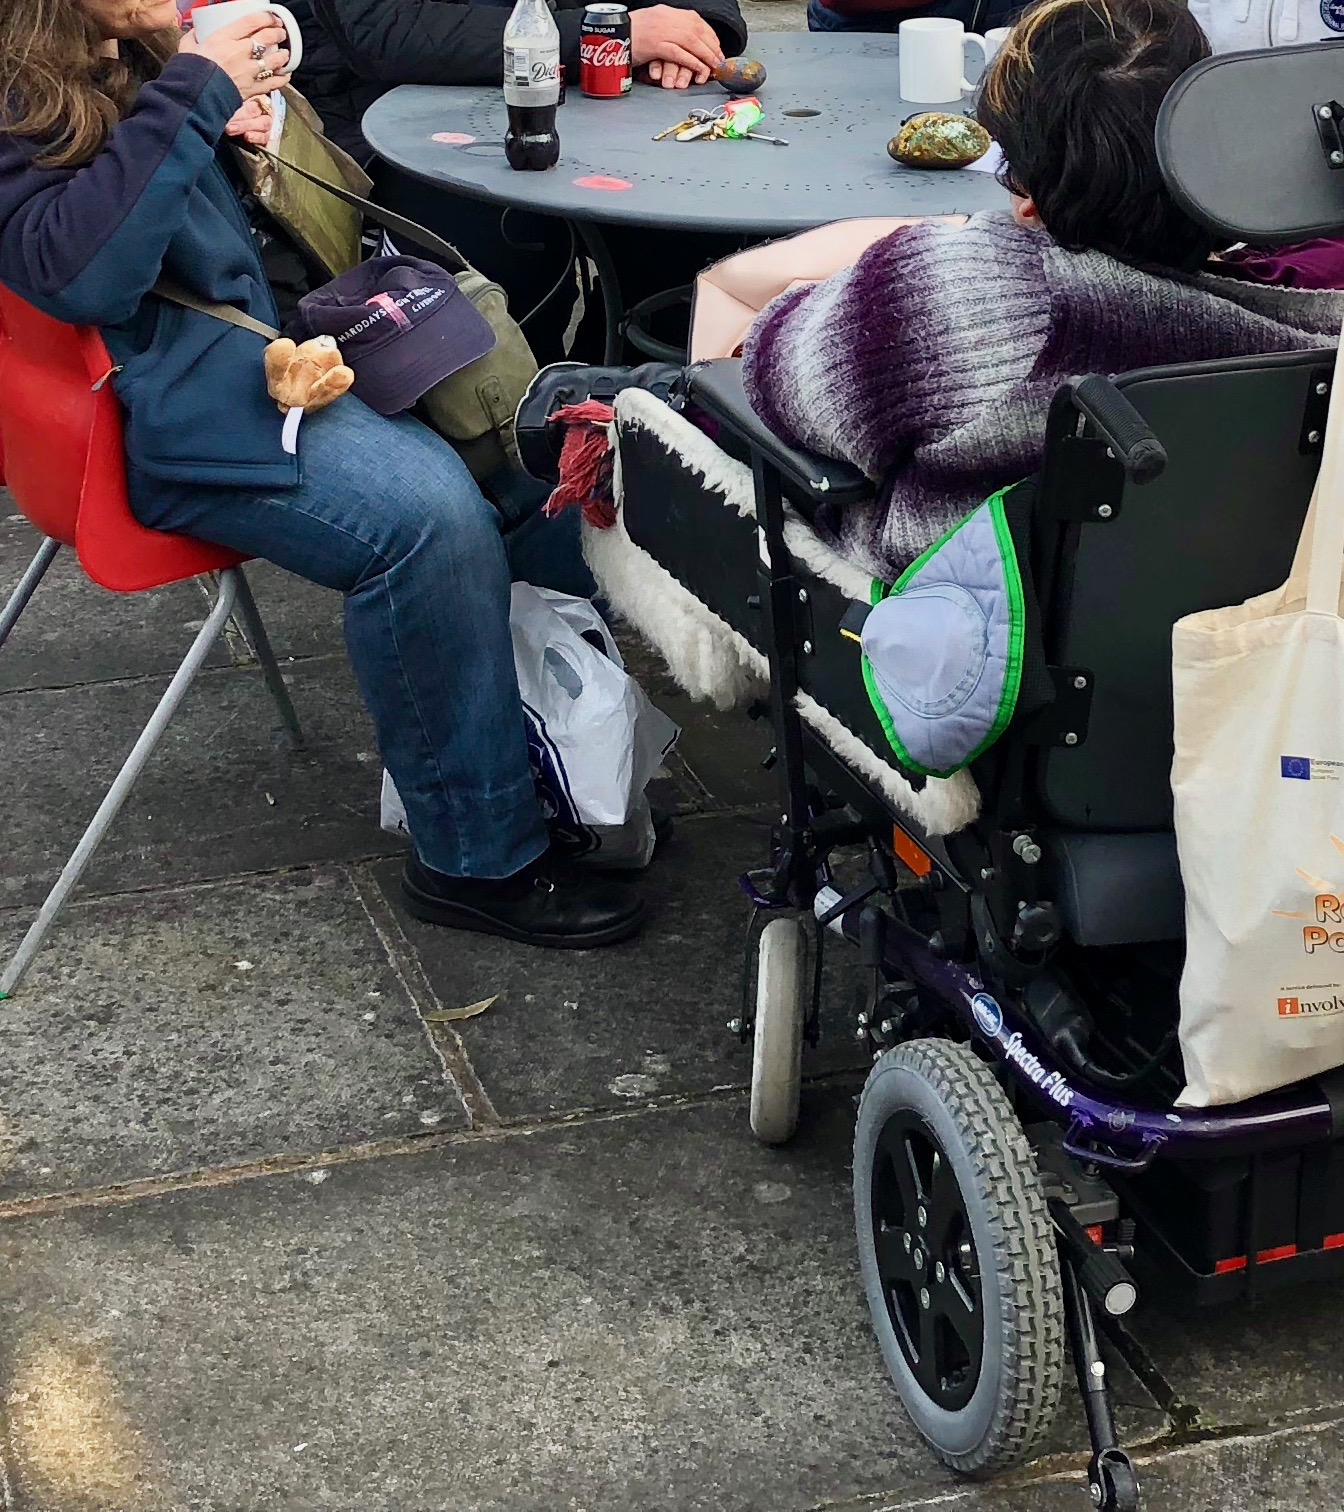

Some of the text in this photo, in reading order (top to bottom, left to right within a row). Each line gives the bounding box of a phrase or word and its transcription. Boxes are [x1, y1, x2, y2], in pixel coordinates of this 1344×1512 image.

[580, 37, 630, 67] ca-Cola
[1002, 1031, 1075, 1108] Spectra Plus
